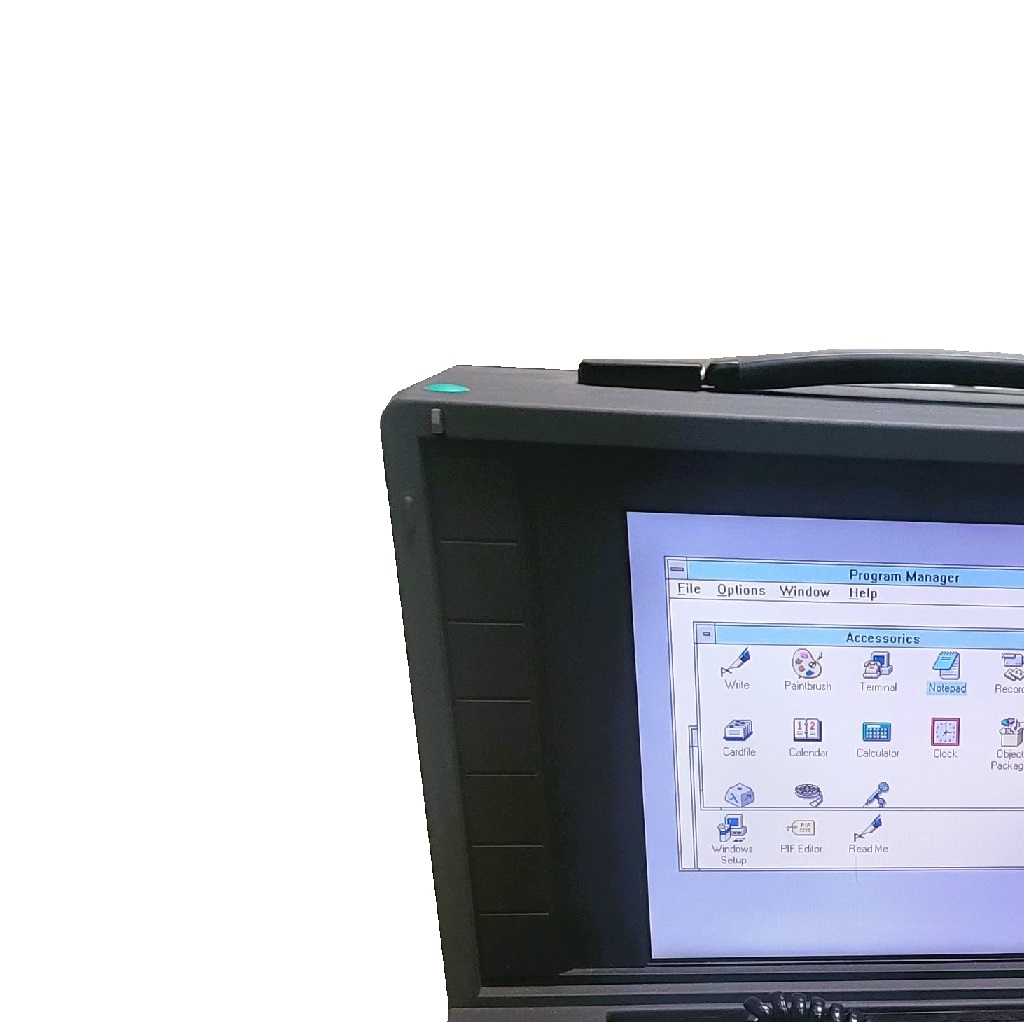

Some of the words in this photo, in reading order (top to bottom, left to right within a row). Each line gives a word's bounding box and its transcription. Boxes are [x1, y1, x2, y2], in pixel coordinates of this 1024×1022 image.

[850, 568, 901, 582] Program
[906, 571, 960, 585] Manager
[677, 584, 701, 596] File
[717, 584, 766, 597] Options
[780, 586, 830, 598] Window
[849, 588, 878, 600] Help
[846, 633, 920, 644] Accessories
[724, 680, 750, 690] Write
[784, 680, 832, 691] Paintbrush
[860, 682, 898, 692] Terminal
[928, 683, 967, 694] Notepad
[722, 747, 756, 757] Cardfile
[789, 748, 828, 758] Calendar
[856, 748, 900, 758] Calculator
[934, 749, 958, 758] Clock
[996, 750, 1024, 760] Object
[712, 844, 752, 854] Windows
[780, 844, 794, 853] PIF
[798, 844, 822, 854] Editor
[849, 844, 872, 853] Read
[874, 844, 888, 853] Me
[720, 856, 748, 866] Setup
